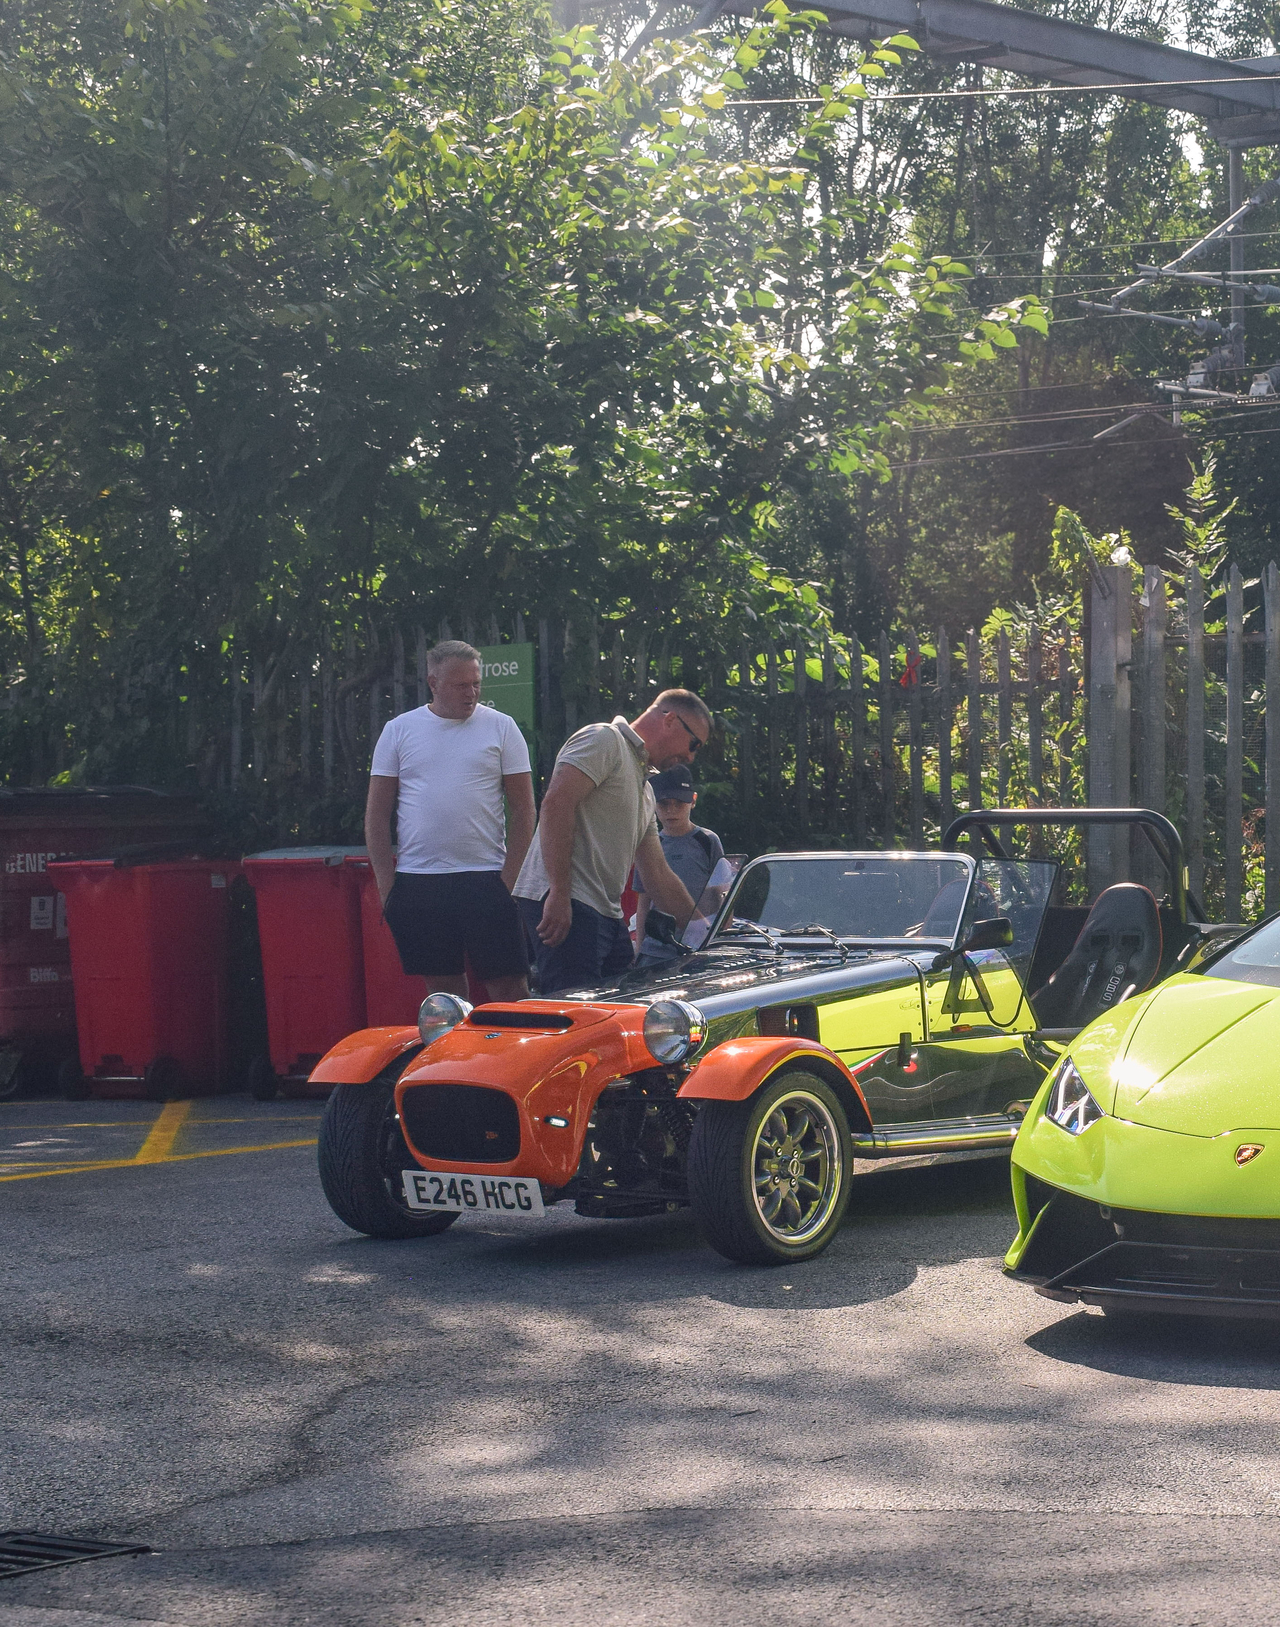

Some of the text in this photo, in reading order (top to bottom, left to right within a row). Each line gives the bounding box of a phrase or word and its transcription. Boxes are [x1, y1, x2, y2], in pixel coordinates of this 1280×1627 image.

[478, 659, 518, 677] trose
[413, 1176, 532, 1210] E246 HCG
